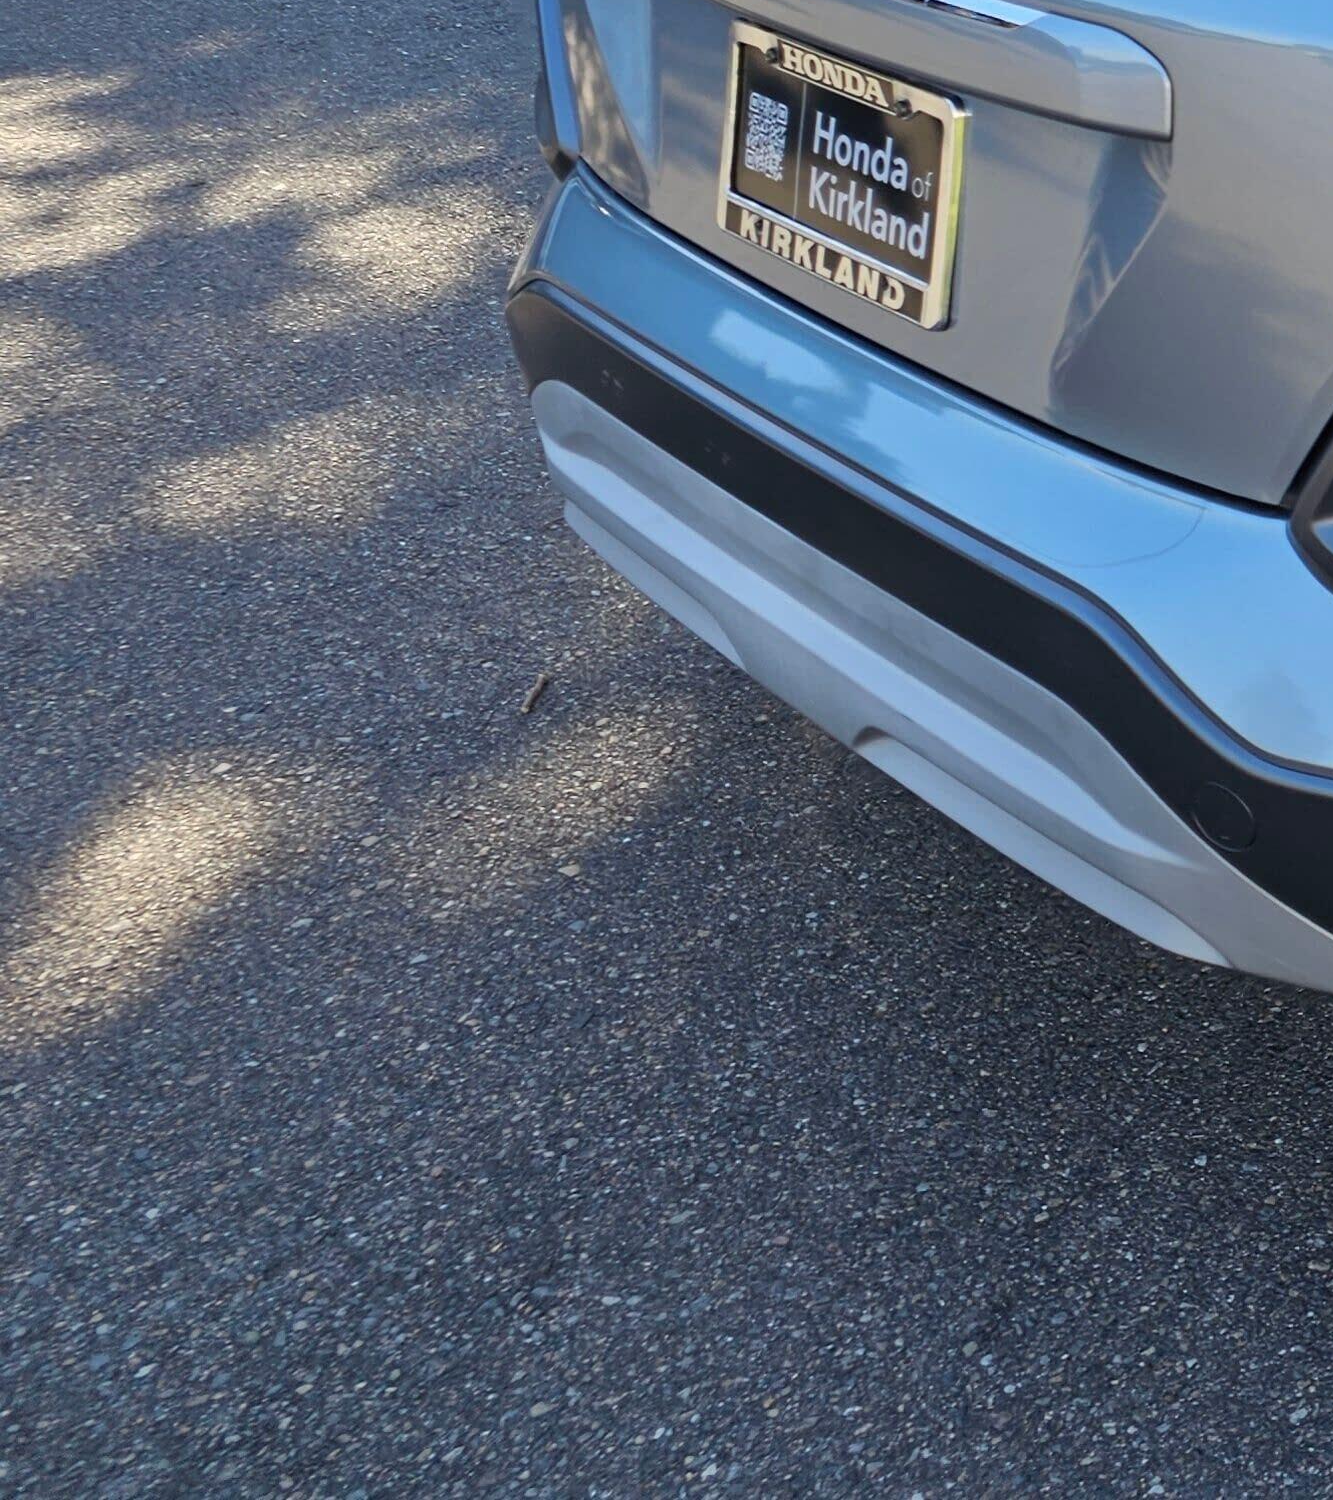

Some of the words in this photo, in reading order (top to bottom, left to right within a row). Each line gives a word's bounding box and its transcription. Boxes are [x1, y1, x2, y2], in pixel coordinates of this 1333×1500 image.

[782, 44, 889, 107] HONDA
[813, 111, 909, 191] Honda
[911, 172, 933, 201] of
[808, 167, 930, 260] Kirkland
[740, 212, 905, 311] KIRKLAND
